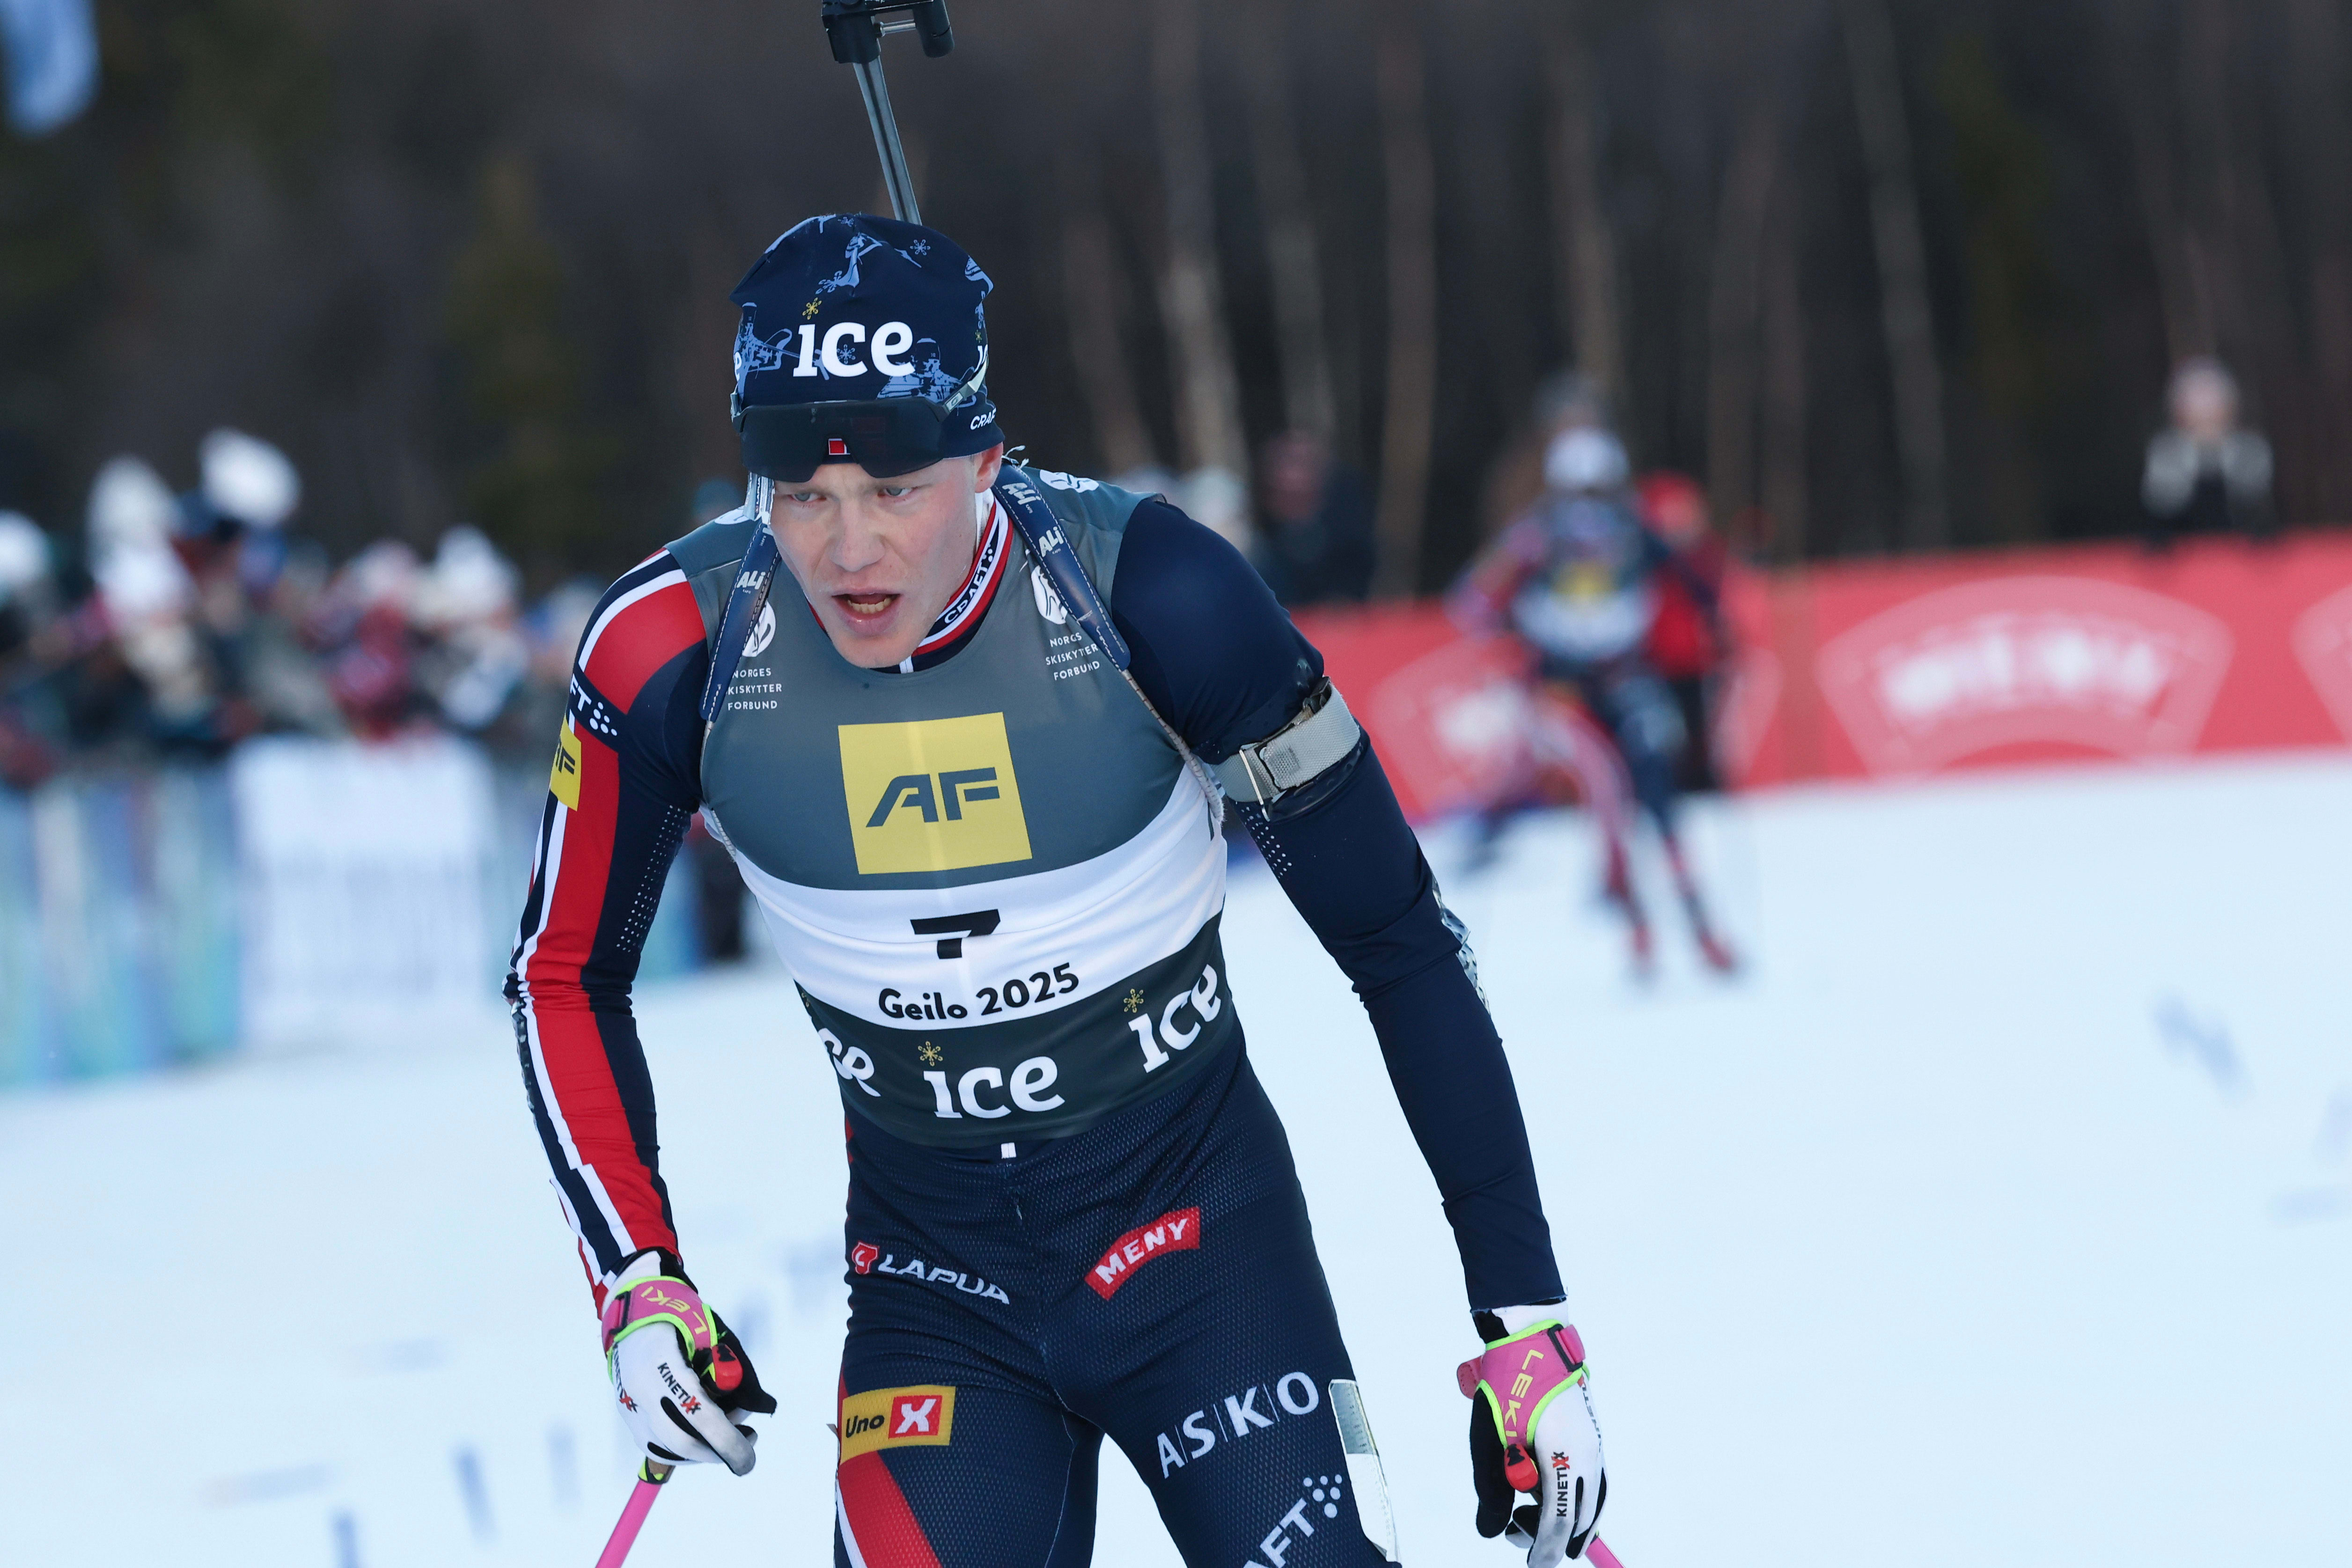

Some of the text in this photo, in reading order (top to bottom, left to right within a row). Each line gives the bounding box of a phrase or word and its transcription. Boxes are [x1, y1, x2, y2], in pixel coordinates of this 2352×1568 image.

[793, 321, 915, 377] ice
[970, 407, 997, 430] CRAF
[726, 684, 782, 695] KISKYTTER
[732, 668, 772, 678] NORGES
[1053, 661, 1100, 681] FORBUND
[728, 700, 777, 711] FORBUND
[866, 767, 1000, 828] AF
[910, 908, 1001, 960] 7
[878, 962, 1080, 1020] Geilo 2025
[1128, 964, 1221, 1074] ice
[923, 1056, 1066, 1119] ice
[1095, 1218, 1189, 1286] MENY
[878, 1254, 1010, 1305] LAPUA
[641, 1286, 707, 1334] LEKI
[1505, 1349, 1544, 1437] LEKI
[845, 1399, 937, 1439] Uno X
